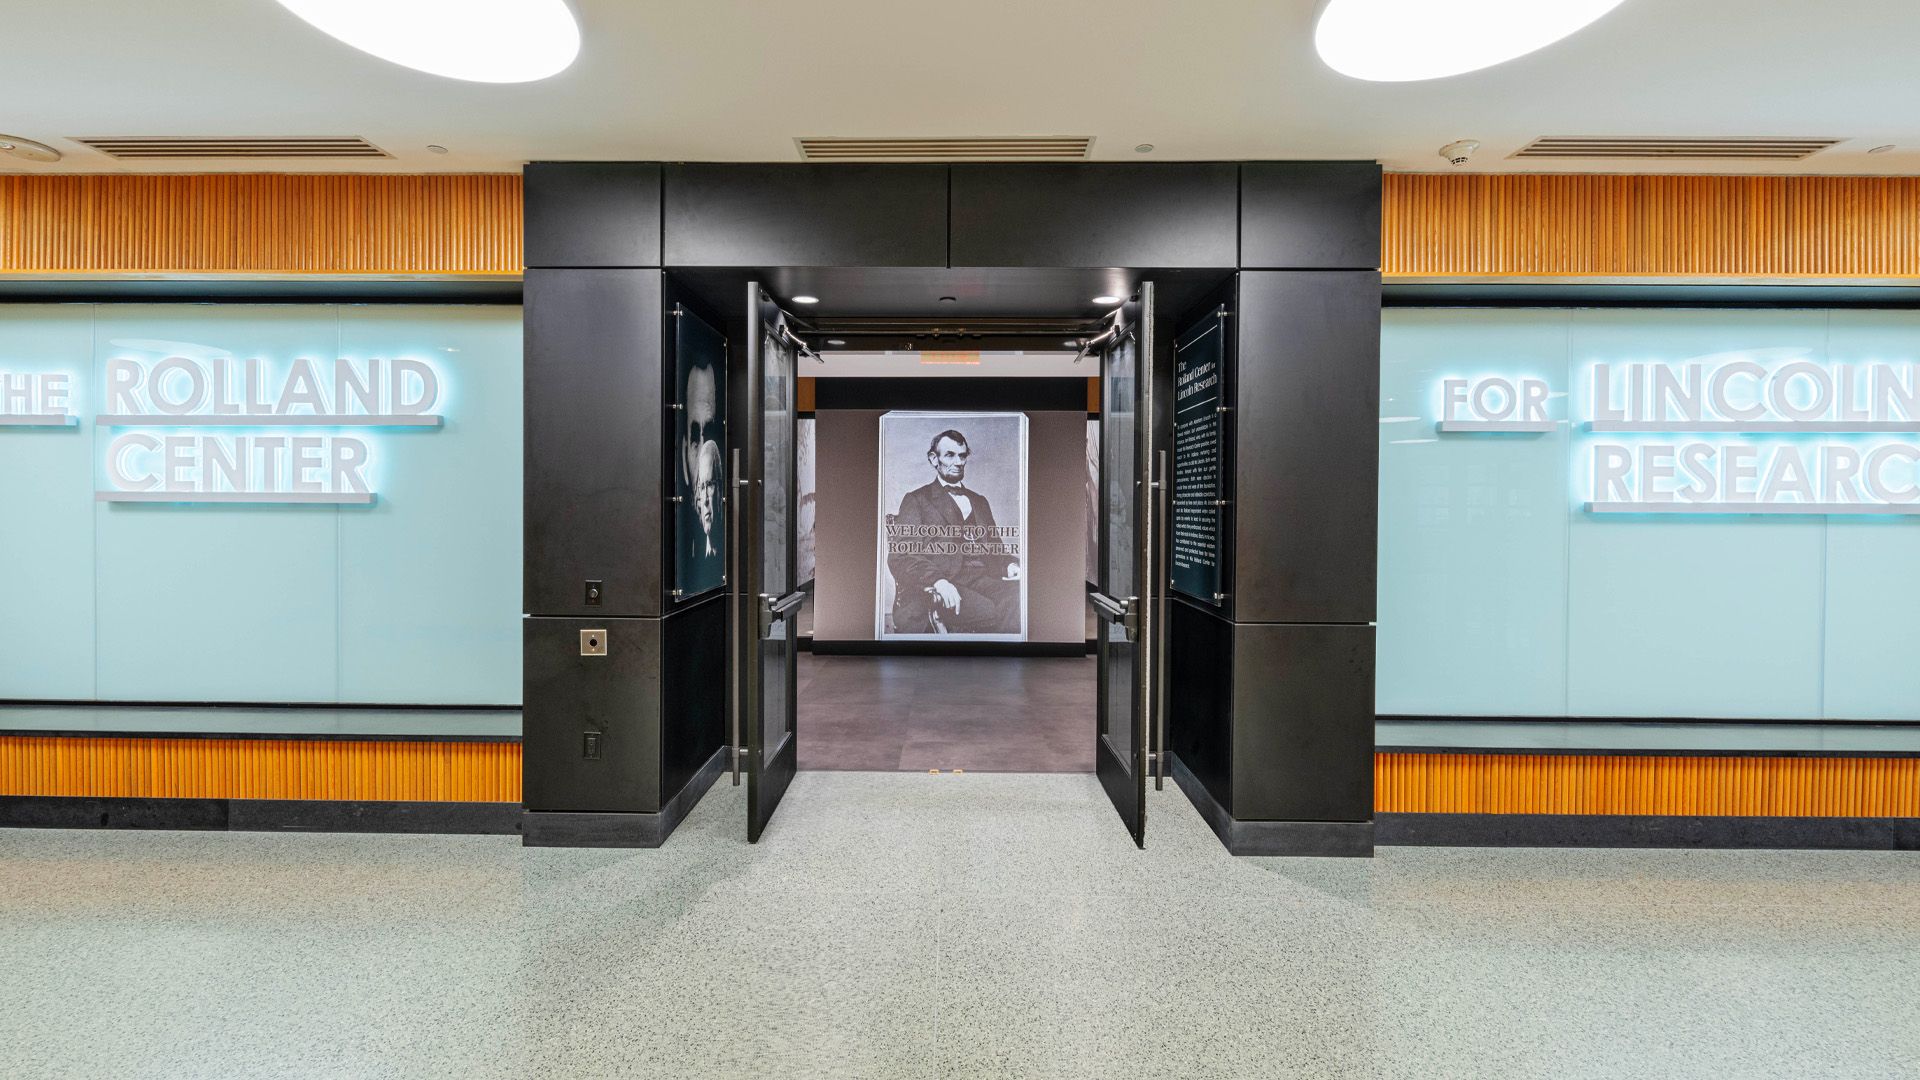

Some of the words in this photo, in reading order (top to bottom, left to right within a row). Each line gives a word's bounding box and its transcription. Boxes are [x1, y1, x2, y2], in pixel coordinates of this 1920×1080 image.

[0, 374, 69, 415] HE
[107, 357, 439, 415] ROLLAND
[1178, 385, 1193, 400] Lincoln
[1194, 372, 1217, 394] Research
[1194, 362, 1210, 378] Center
[1443, 377, 1550, 422] FOR
[1593, 361, 1920, 422] LINCOLN
[109, 433, 369, 492] CENTER
[1593, 443, 1920, 502] RESEARC
[886, 525, 961, 537] WELCOME
[964, 525, 985, 537] TO
[989, 526, 1020, 538] THE
[888, 542, 957, 554] ROLLAND
[961, 543, 1020, 555] CENTER
